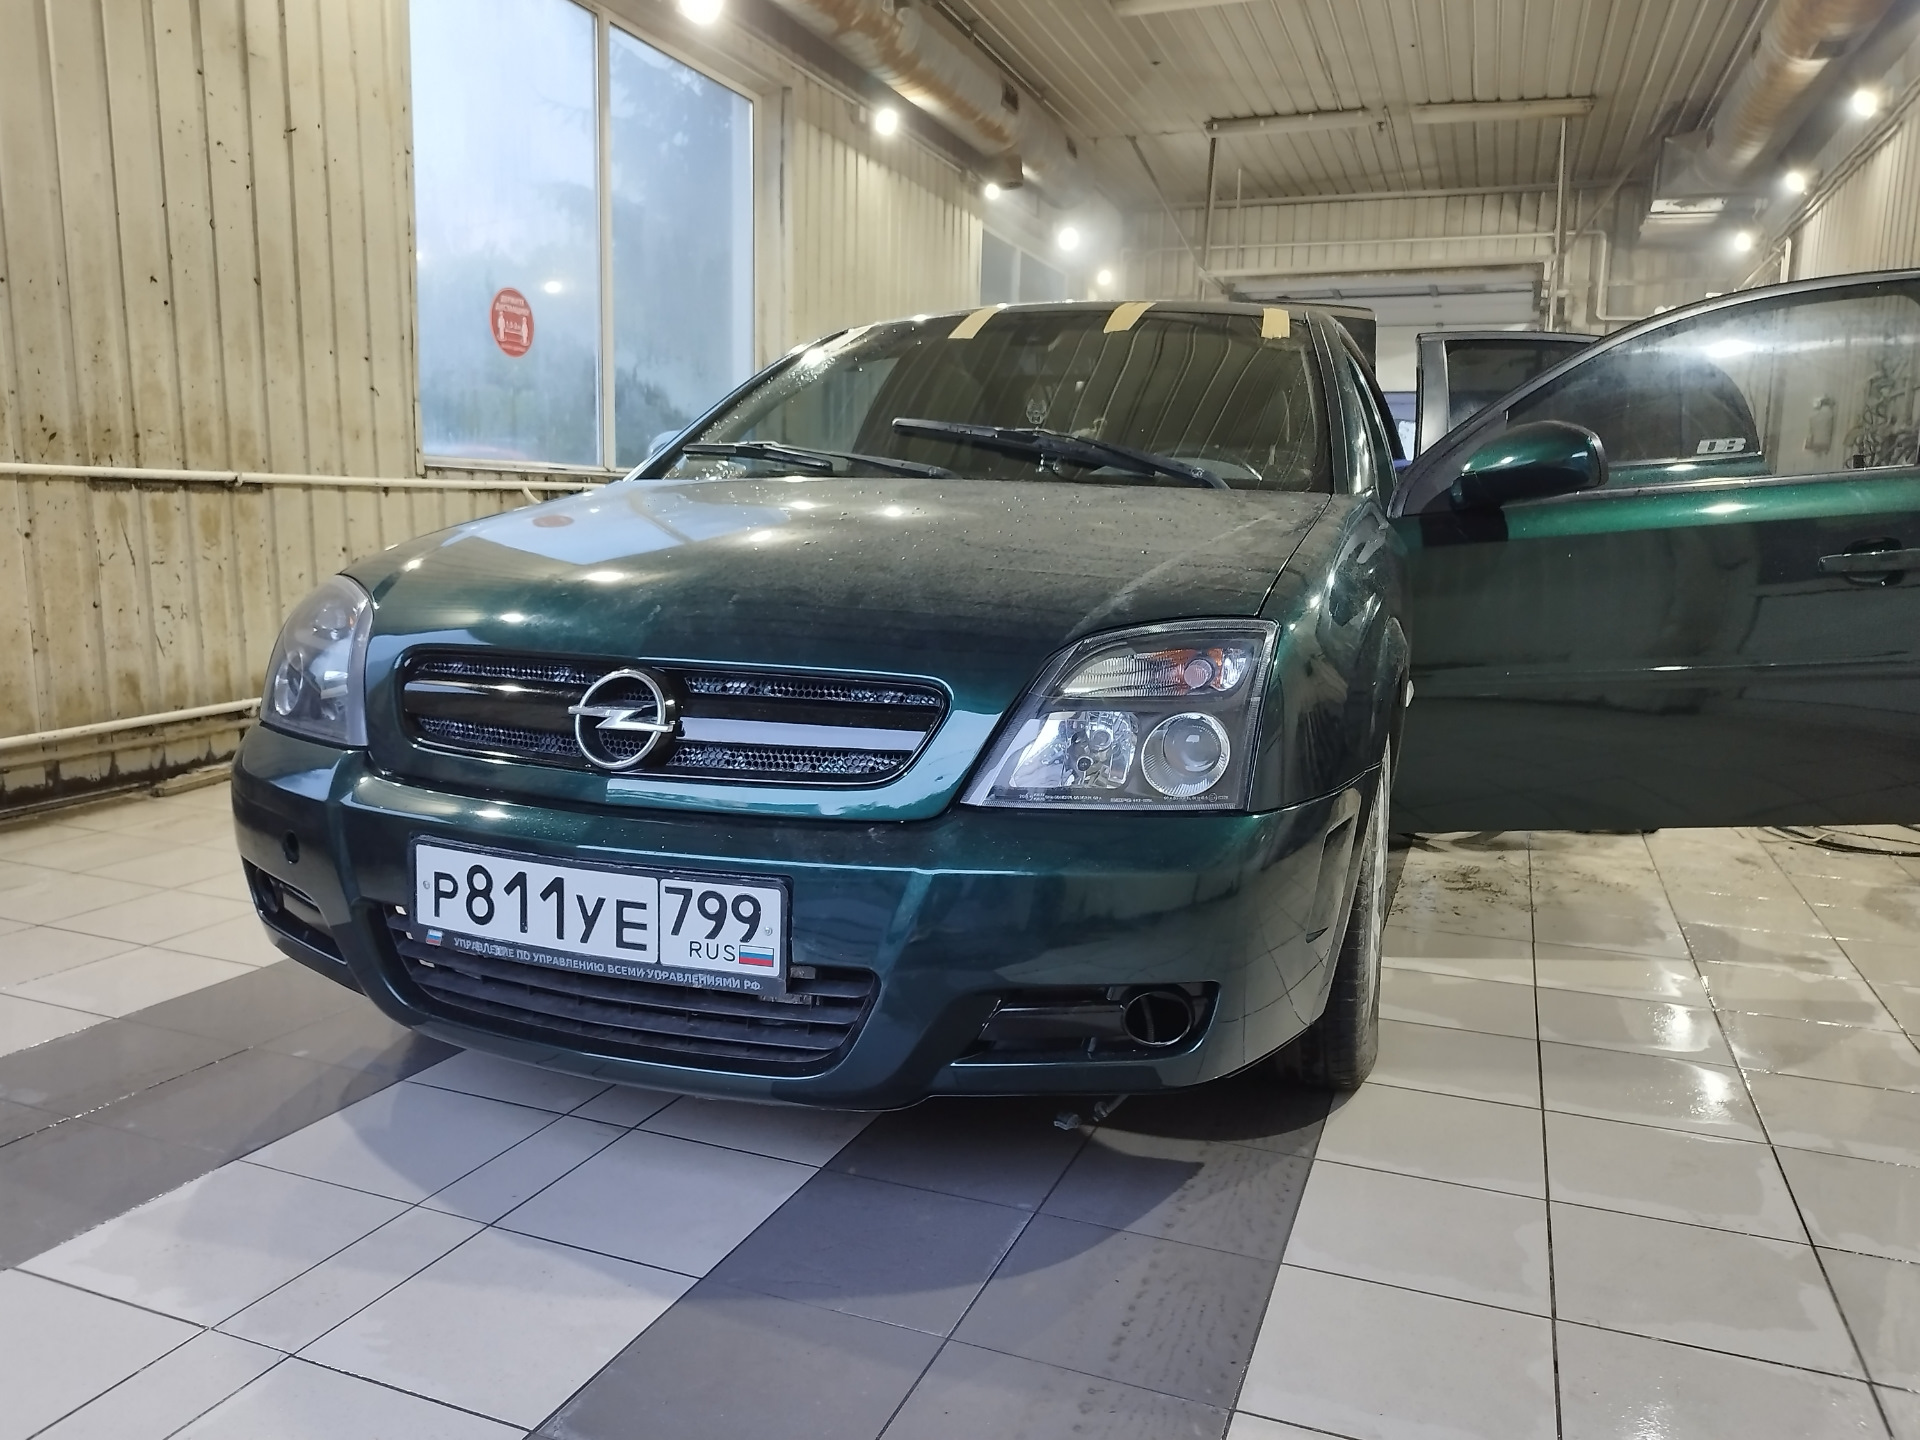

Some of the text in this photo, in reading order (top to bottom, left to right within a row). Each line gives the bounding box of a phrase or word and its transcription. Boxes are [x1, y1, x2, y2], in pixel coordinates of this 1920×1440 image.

[664, 886, 762, 943] 799
[516, 949, 531, 961] ПО
[607, 964, 644, 978] ВСЕМИ
[646, 969, 740, 989] УПРАВЛЕНИЯМИ
[743, 980, 761, 991] РФ
[689, 940, 737, 963] RUS
